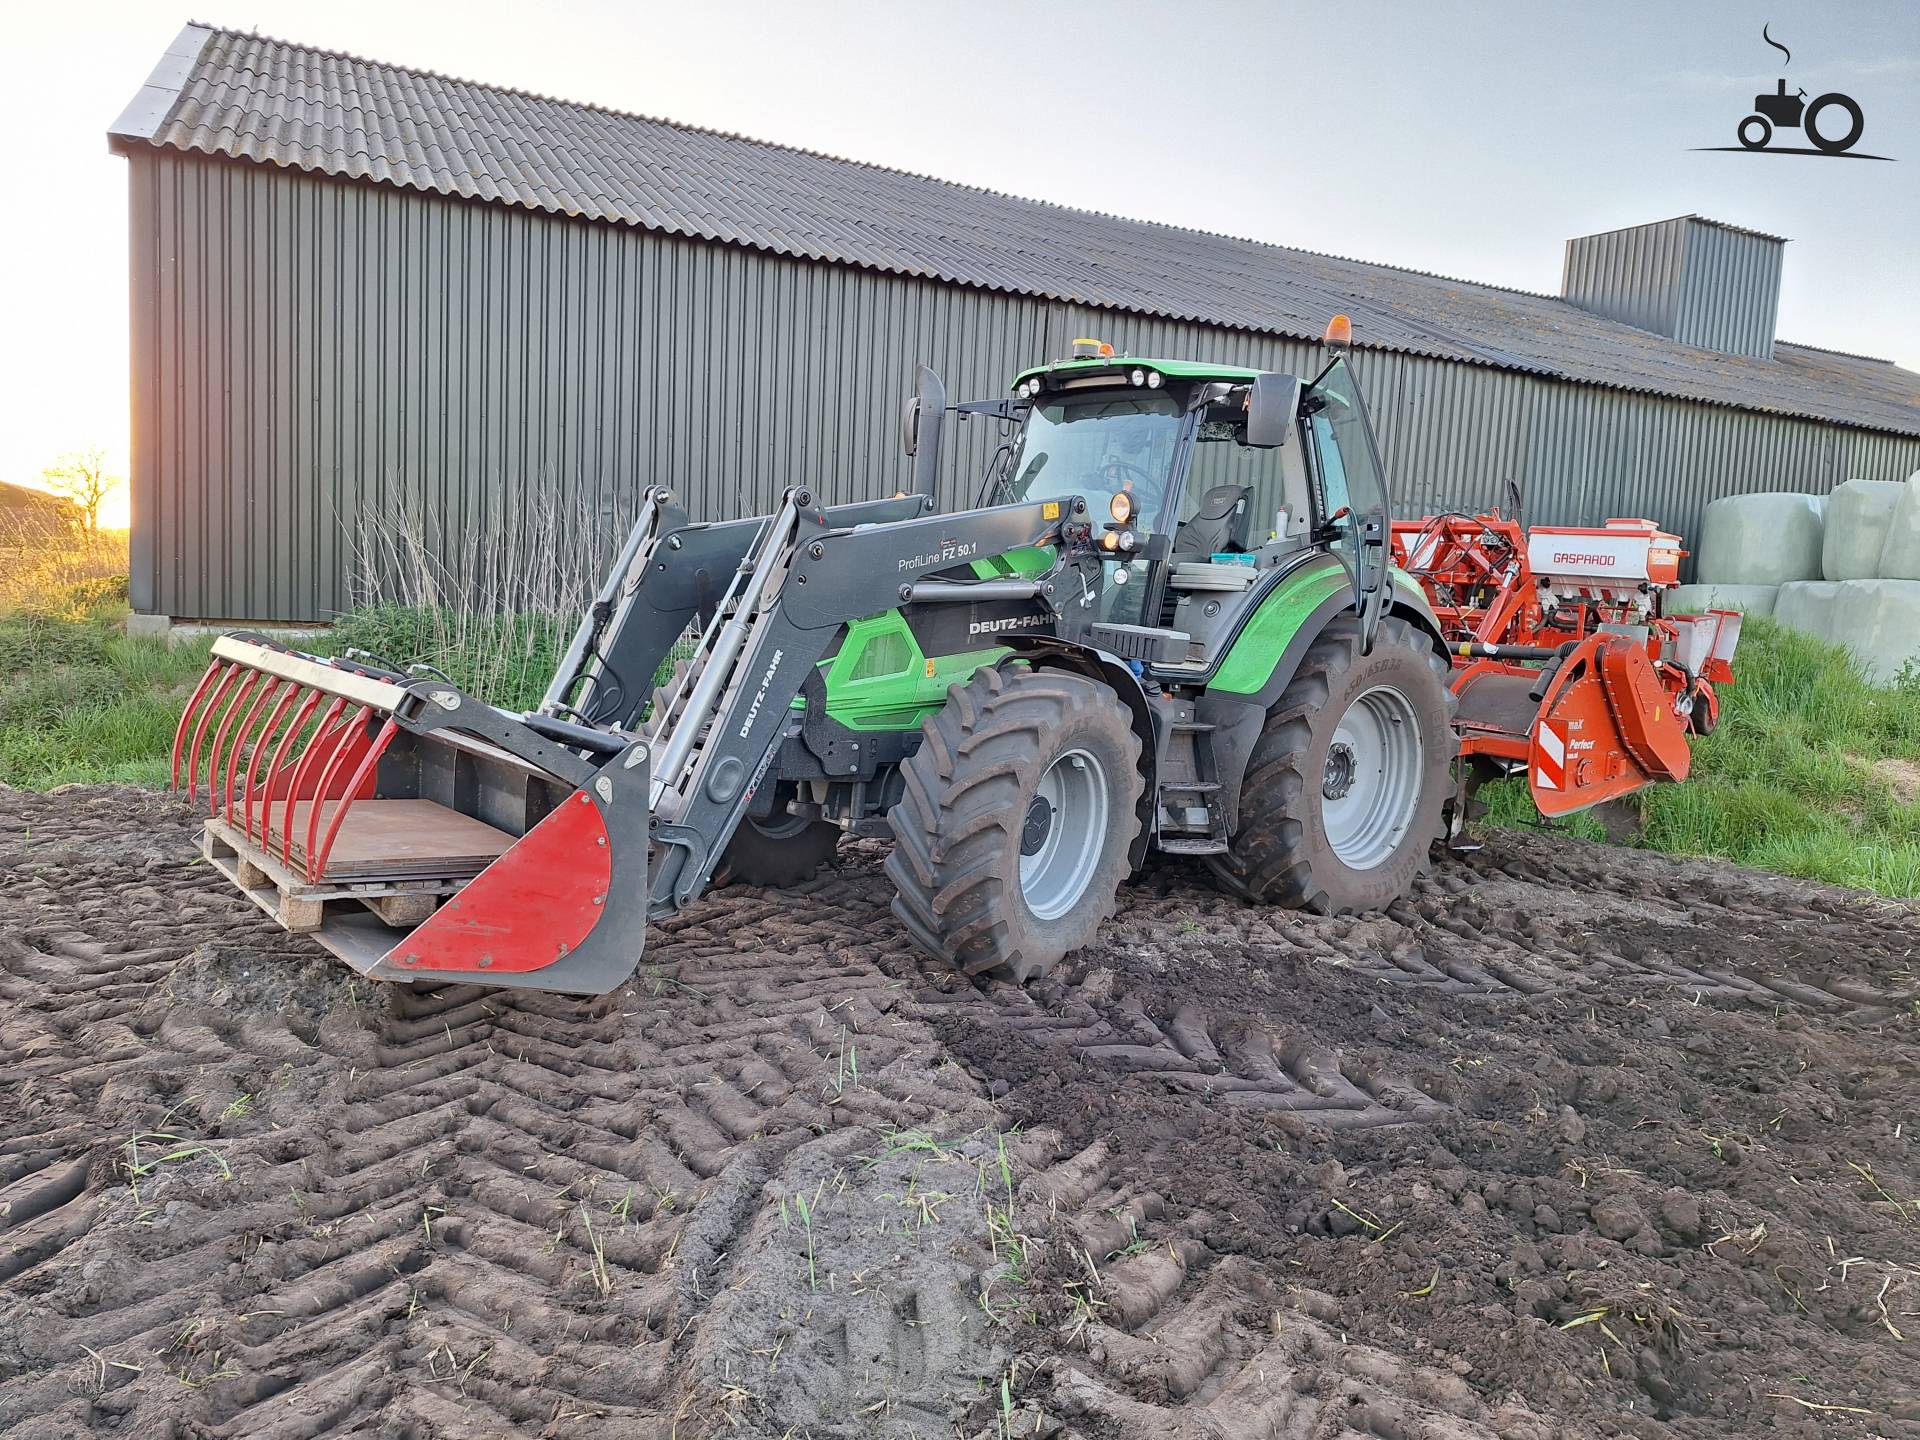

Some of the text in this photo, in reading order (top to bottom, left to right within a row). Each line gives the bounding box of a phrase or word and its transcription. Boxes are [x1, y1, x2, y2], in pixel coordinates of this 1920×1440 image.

[898, 553, 940, 572] ProfiLine
[942, 547, 956, 561] FZ
[957, 542, 977, 557] 50.1
[1553, 552, 1616, 566] GASPARDO
[739, 649, 784, 739] DEUTZ-FAHR
[1569, 738, 1596, 750] Perfect
